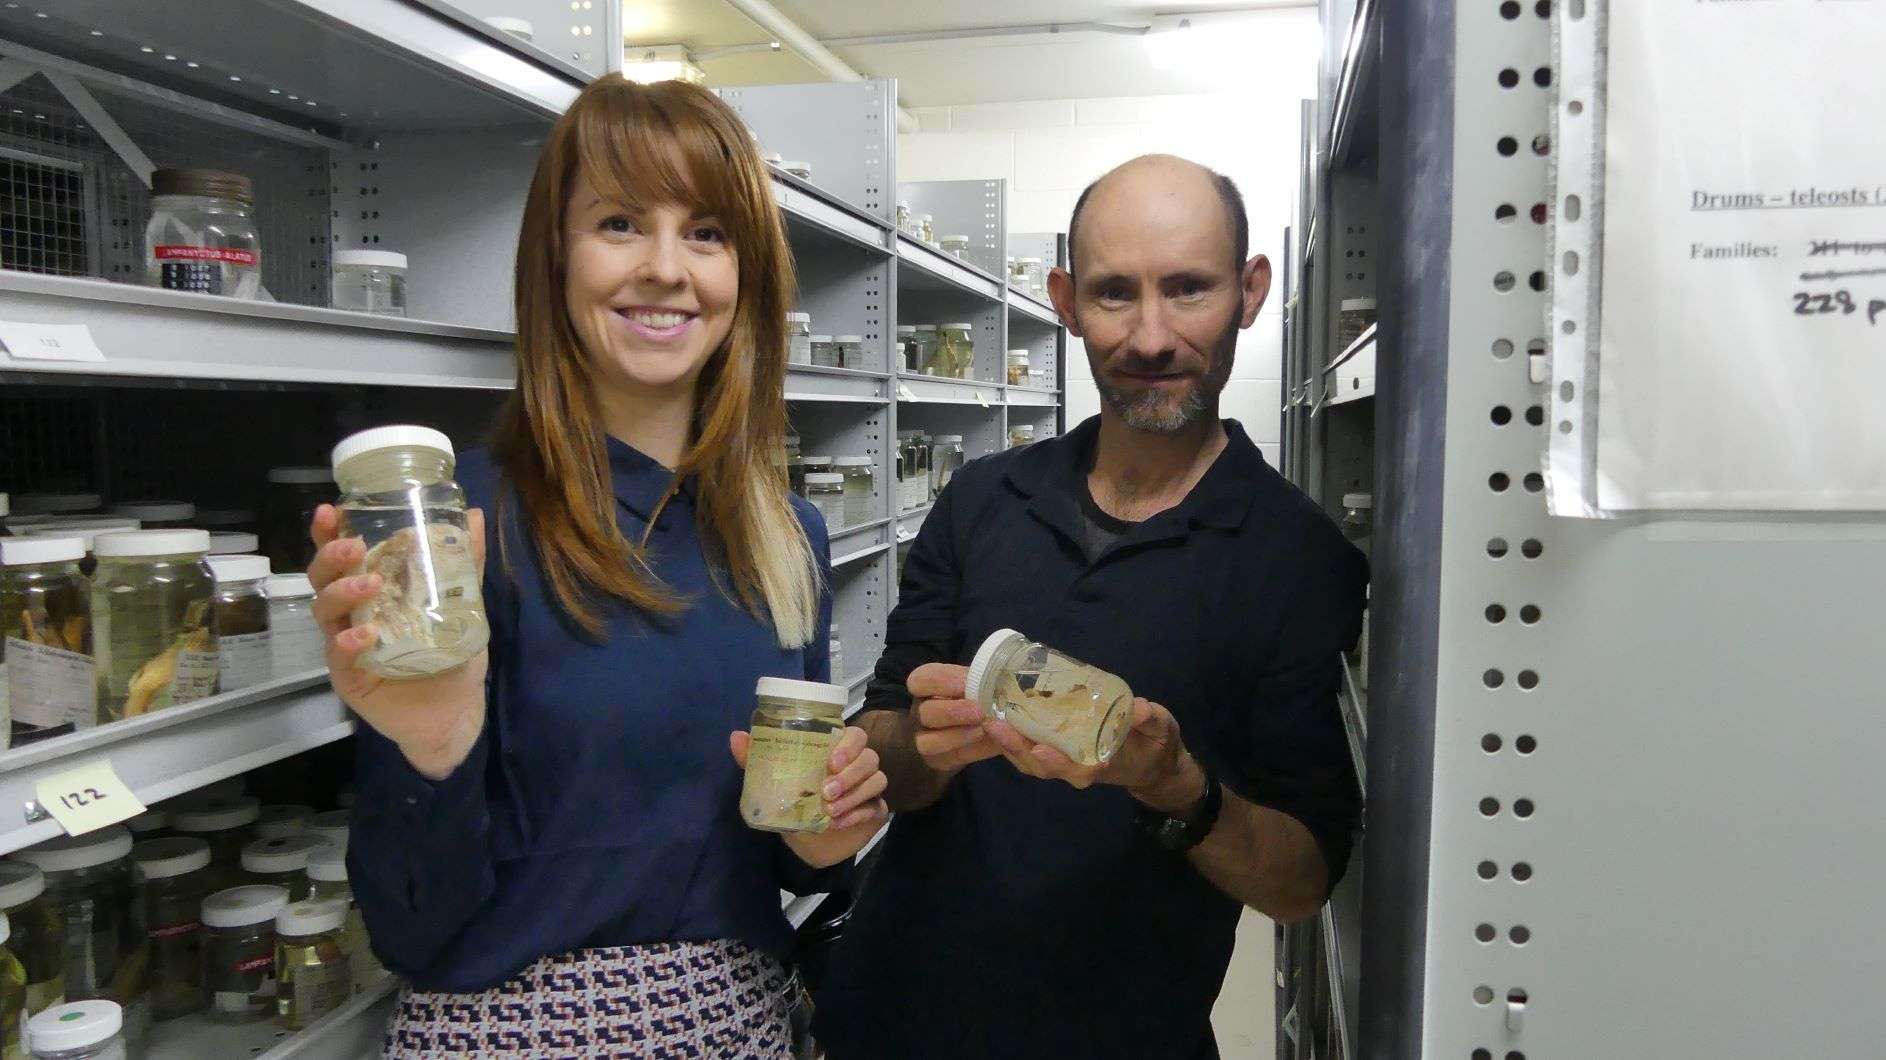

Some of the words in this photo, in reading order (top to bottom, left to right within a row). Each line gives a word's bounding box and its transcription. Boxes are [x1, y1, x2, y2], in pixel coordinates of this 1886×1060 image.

[1691, 190, 1765, 209] Drums
[1790, 185, 1869, 207] teleosts
[1689, 242, 1778, 260] Families:
[1793, 290, 1856, 316] 228
[60, 788, 108, 811] 122
